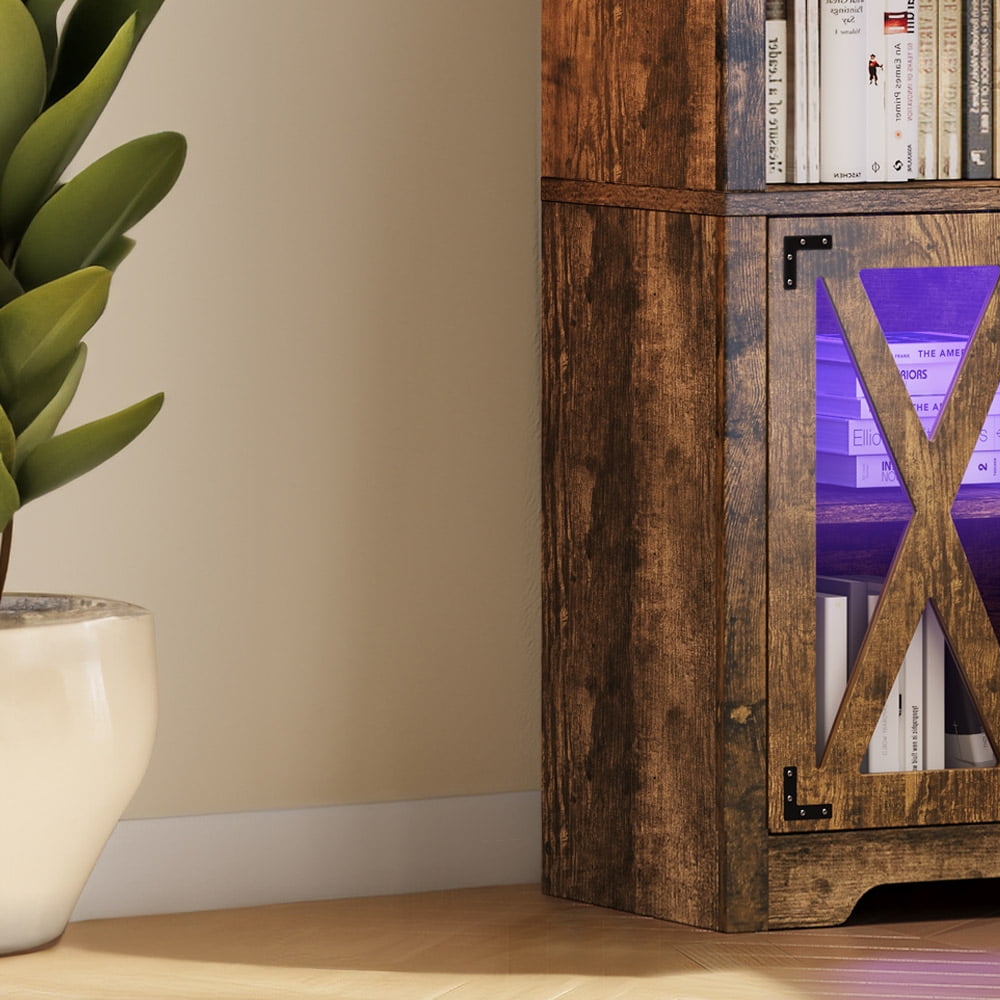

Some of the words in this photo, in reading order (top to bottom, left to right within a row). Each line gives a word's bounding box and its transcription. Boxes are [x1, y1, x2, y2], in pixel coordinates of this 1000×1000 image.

[918, 350, 936, 358] THE
[900, 370, 928, 380] RIORS
[913, 403, 929, 412] HE
[853, 429, 882, 446] Ellio
